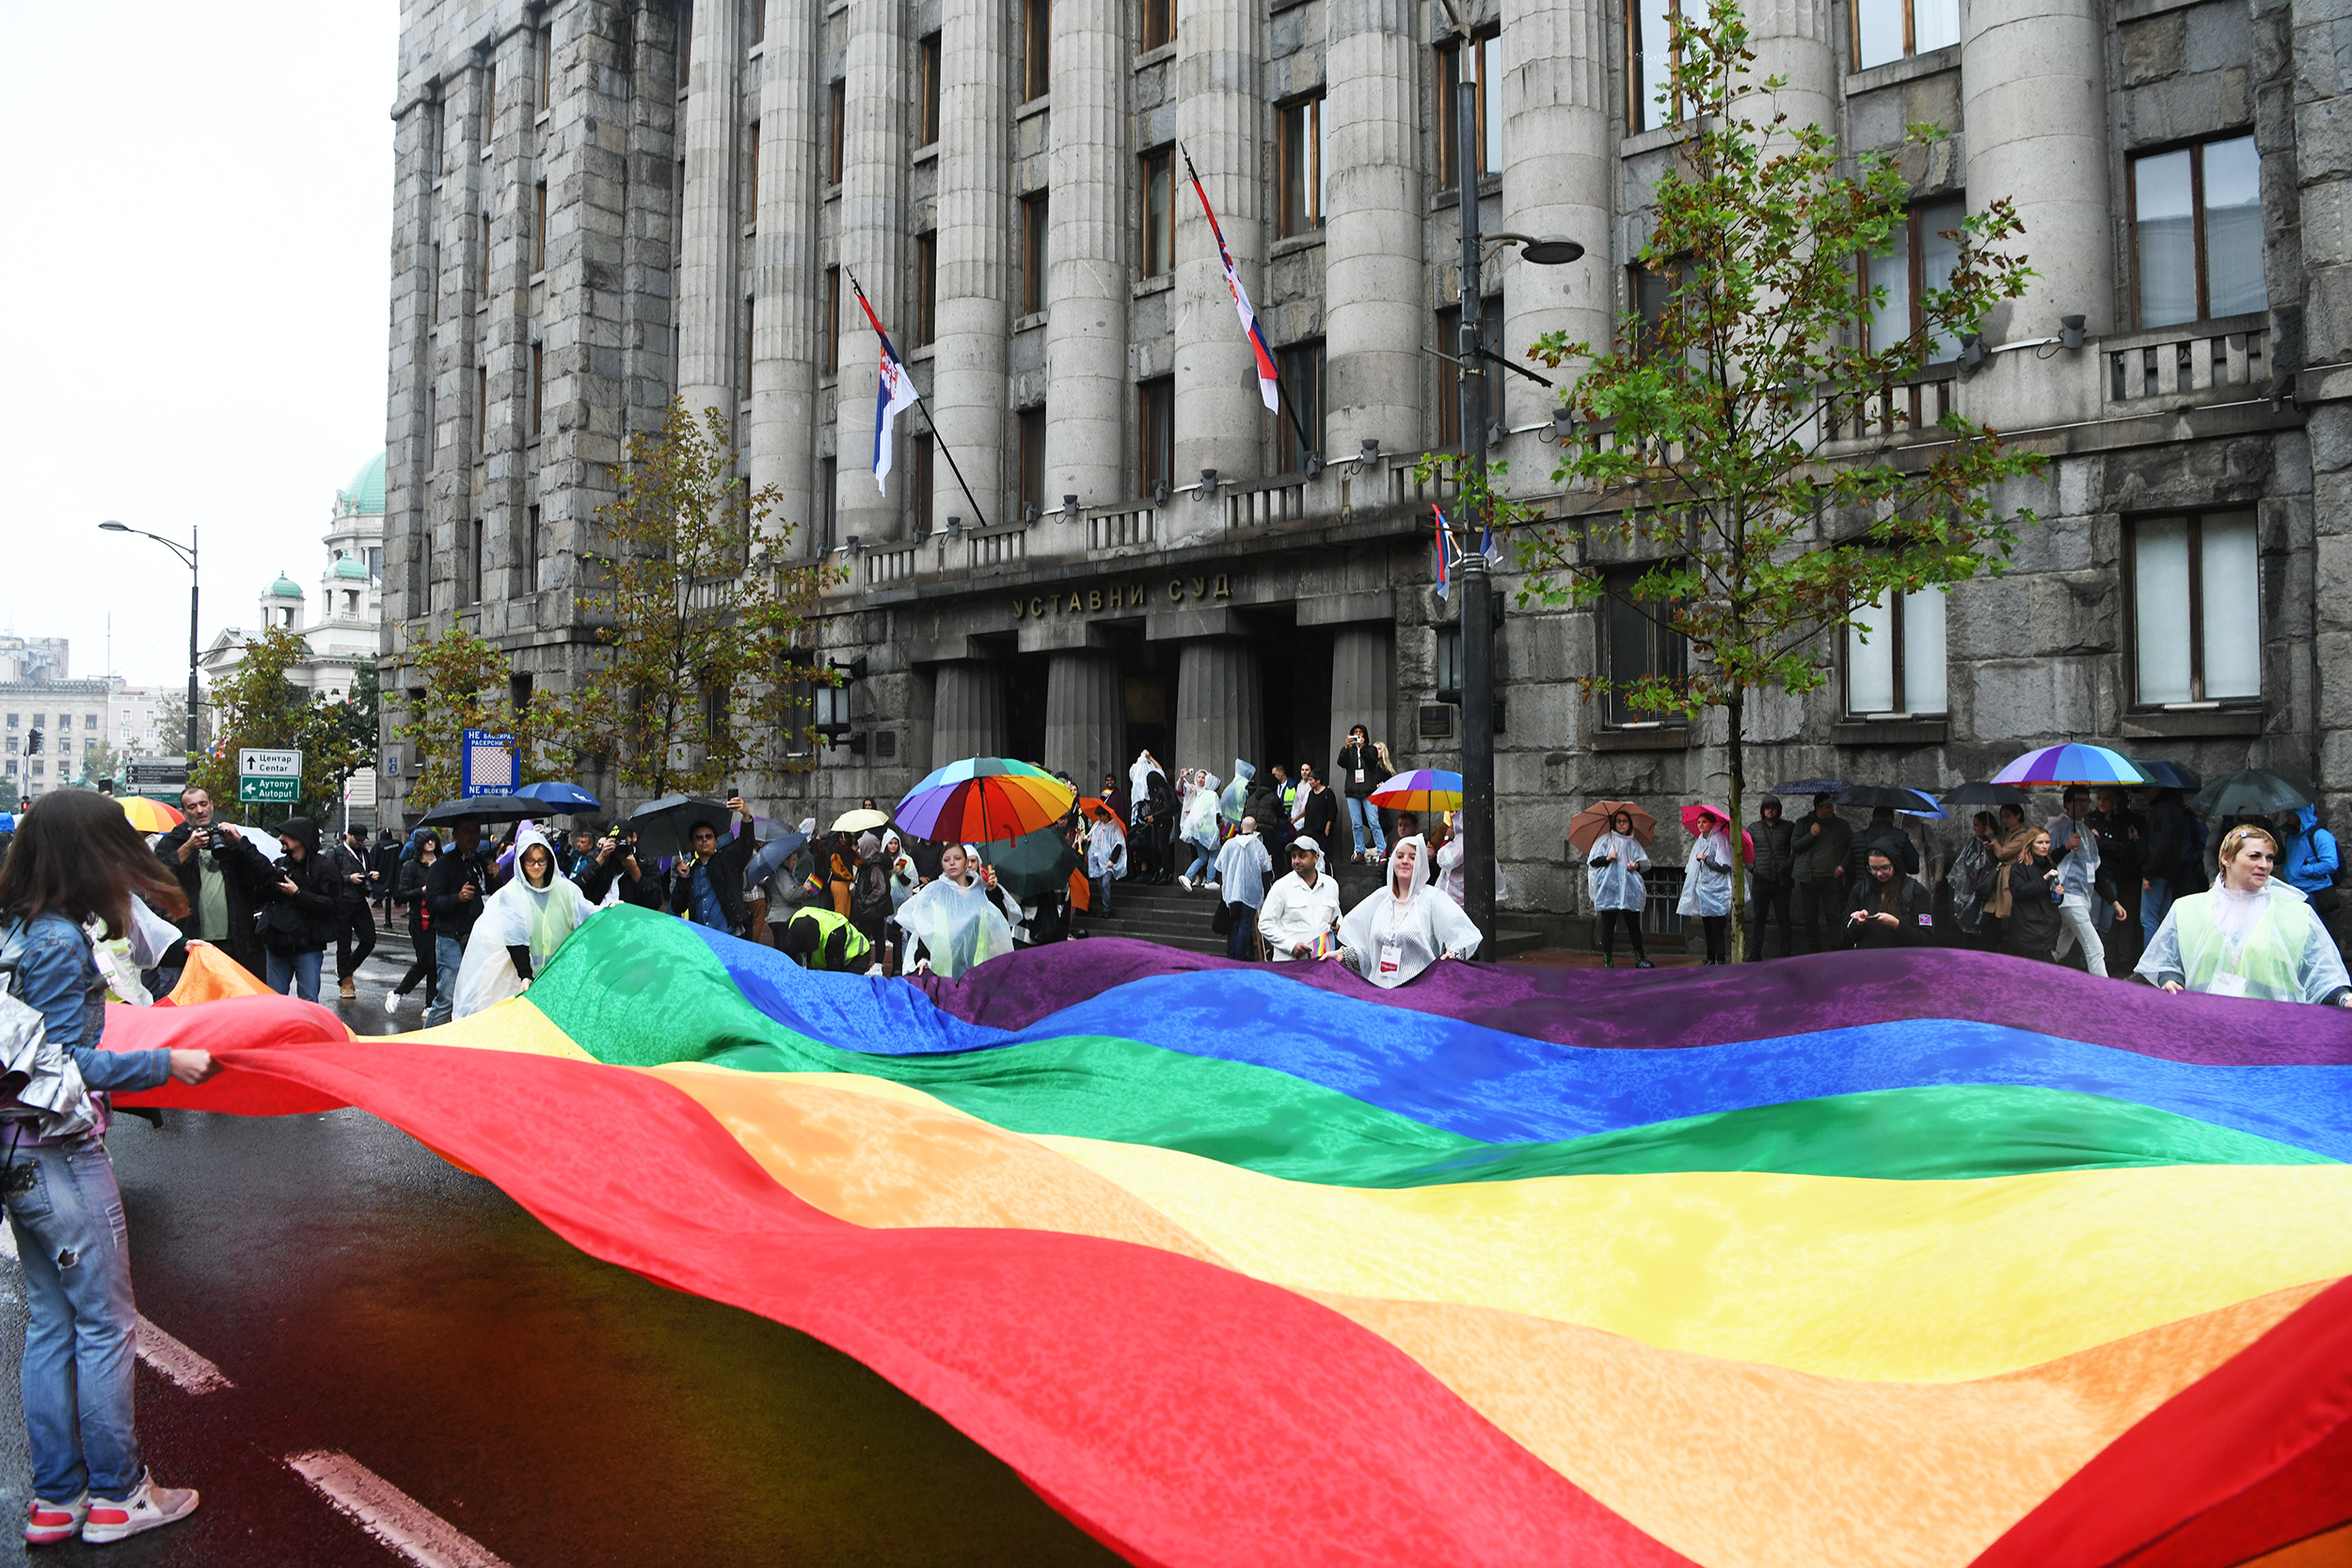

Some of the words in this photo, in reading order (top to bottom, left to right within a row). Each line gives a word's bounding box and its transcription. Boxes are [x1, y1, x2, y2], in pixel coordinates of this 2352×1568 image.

[1011, 583, 1145, 619] УСТАВНИ
[1168, 573, 1230, 601] СУД
[469, 731, 480, 739] НЕ
[260, 754, 292, 764] Центар
[260, 779, 294, 789] Аутопут
[259, 789, 292, 799] Autoput
[469, 785, 481, 794] NE
